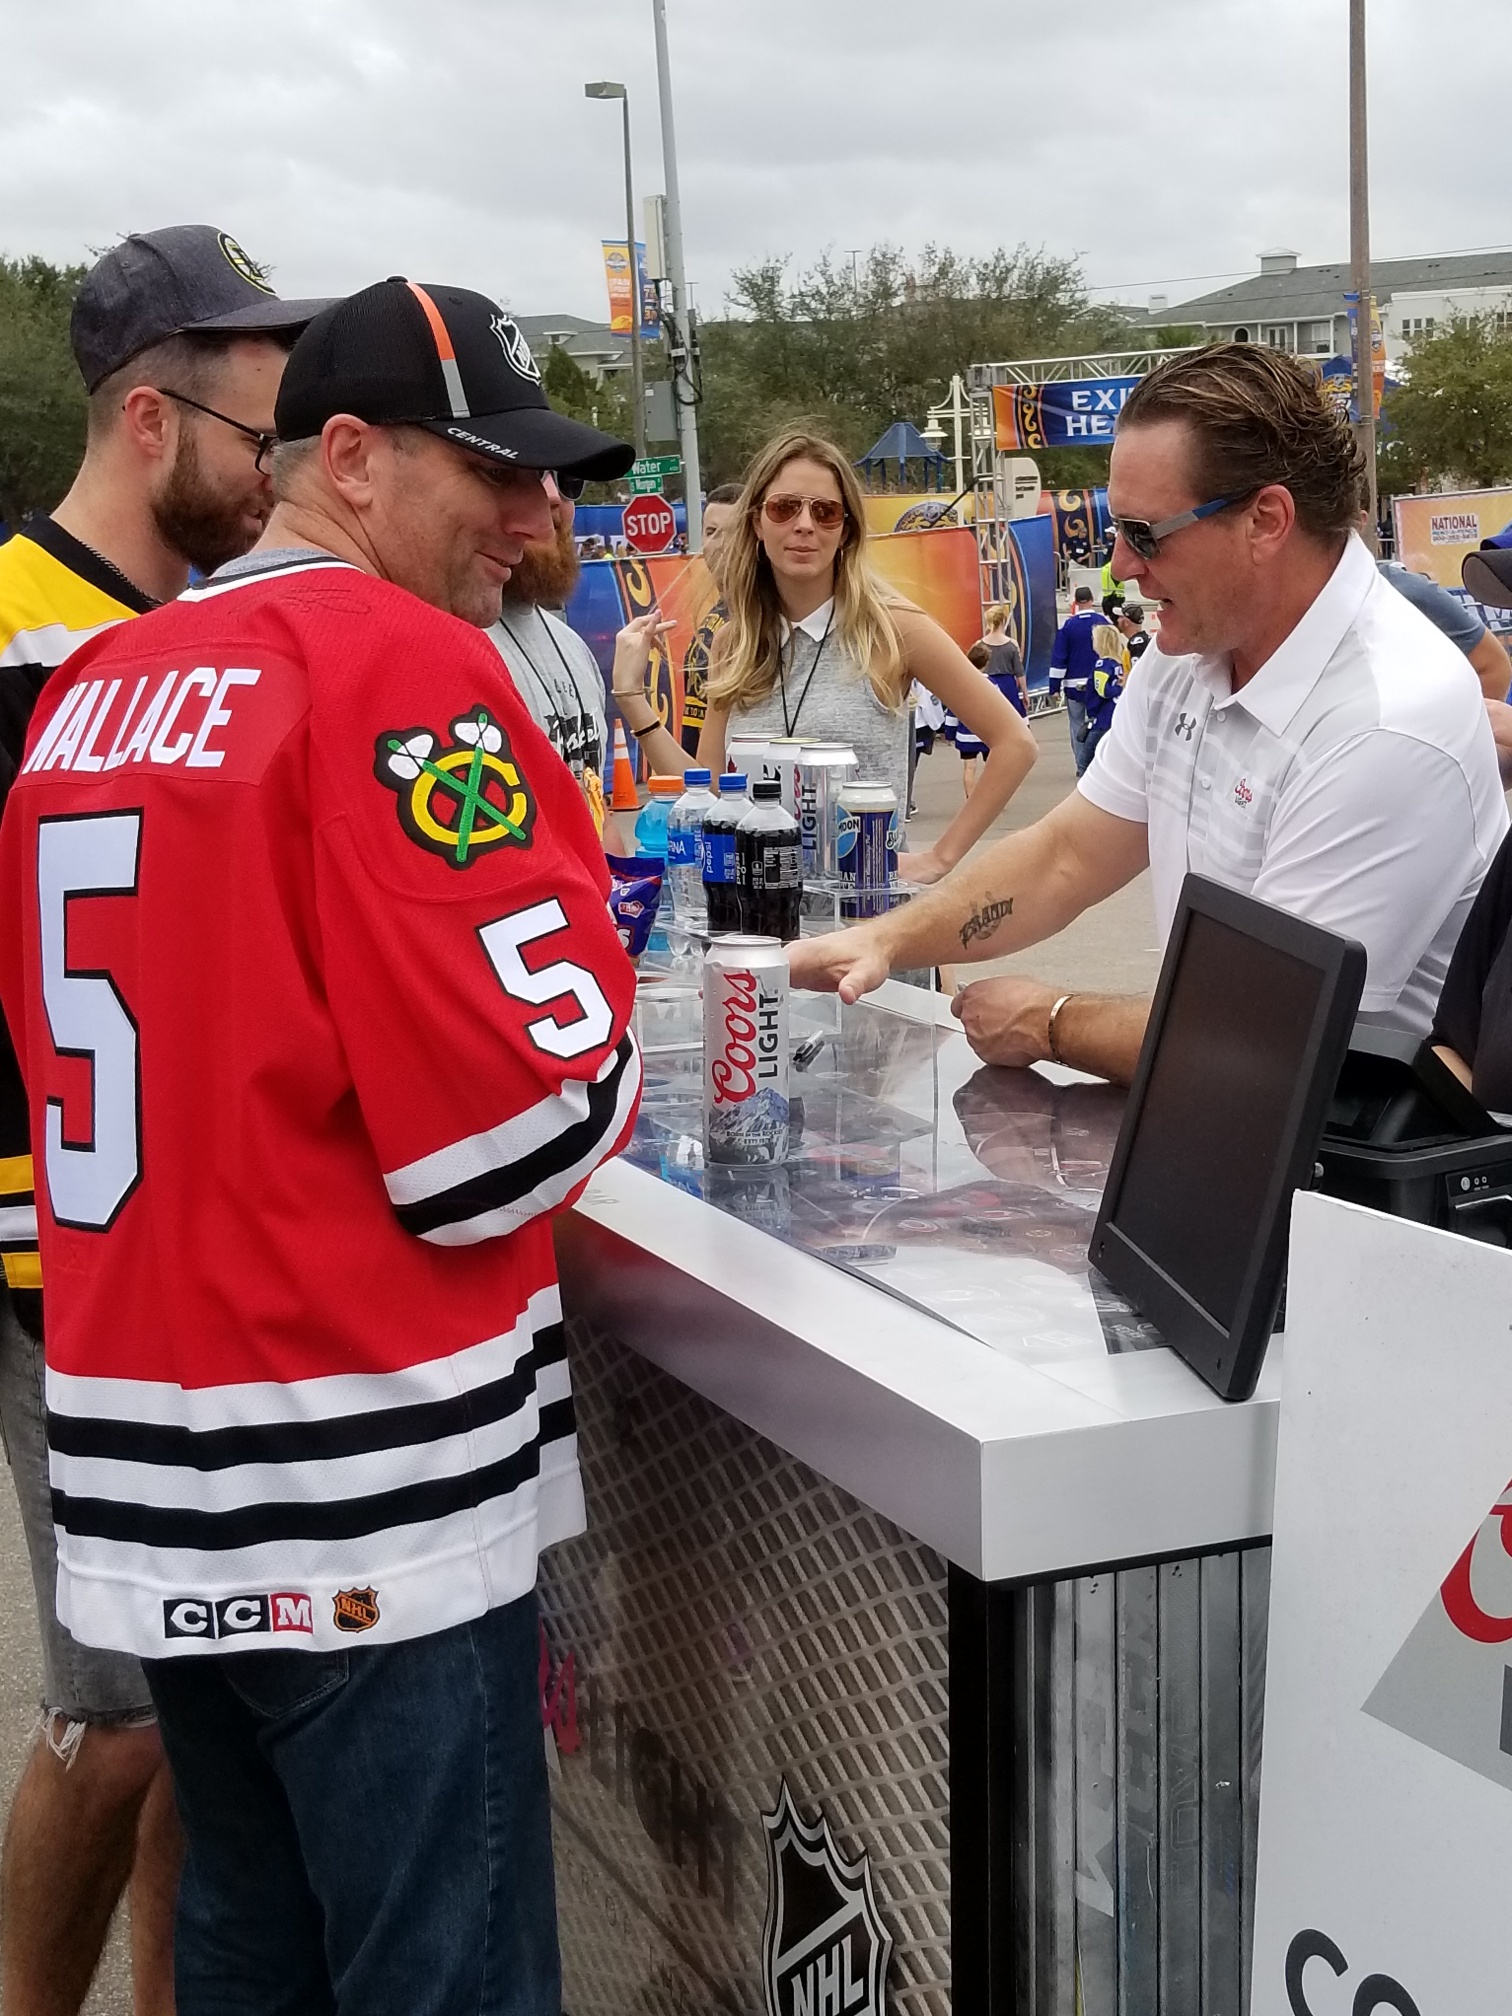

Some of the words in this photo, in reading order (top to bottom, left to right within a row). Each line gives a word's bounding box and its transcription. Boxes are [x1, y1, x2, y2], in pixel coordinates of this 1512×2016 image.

[1065, 414, 1119, 437] HE
[447, 427, 520, 460] CENTRAL
[632, 460, 661, 475] Water
[627, 512, 671, 537] STOP
[1431, 515, 1477, 530] NATIONAL
[22, 667, 262, 776] WALLACE
[801, 785, 817, 850] LIGHT
[704, 841, 714, 874] pepsi
[475, 895, 615, 1062] 5
[38, 807, 145, 1233] 5
[711, 969, 757, 1104] Coors
[758, 993, 779, 1078] LIGHT
[168, 1597, 313, 1634] CCM
[342, 1599, 372, 1623] NHL
[790, 1934, 864, 2016] NHL
